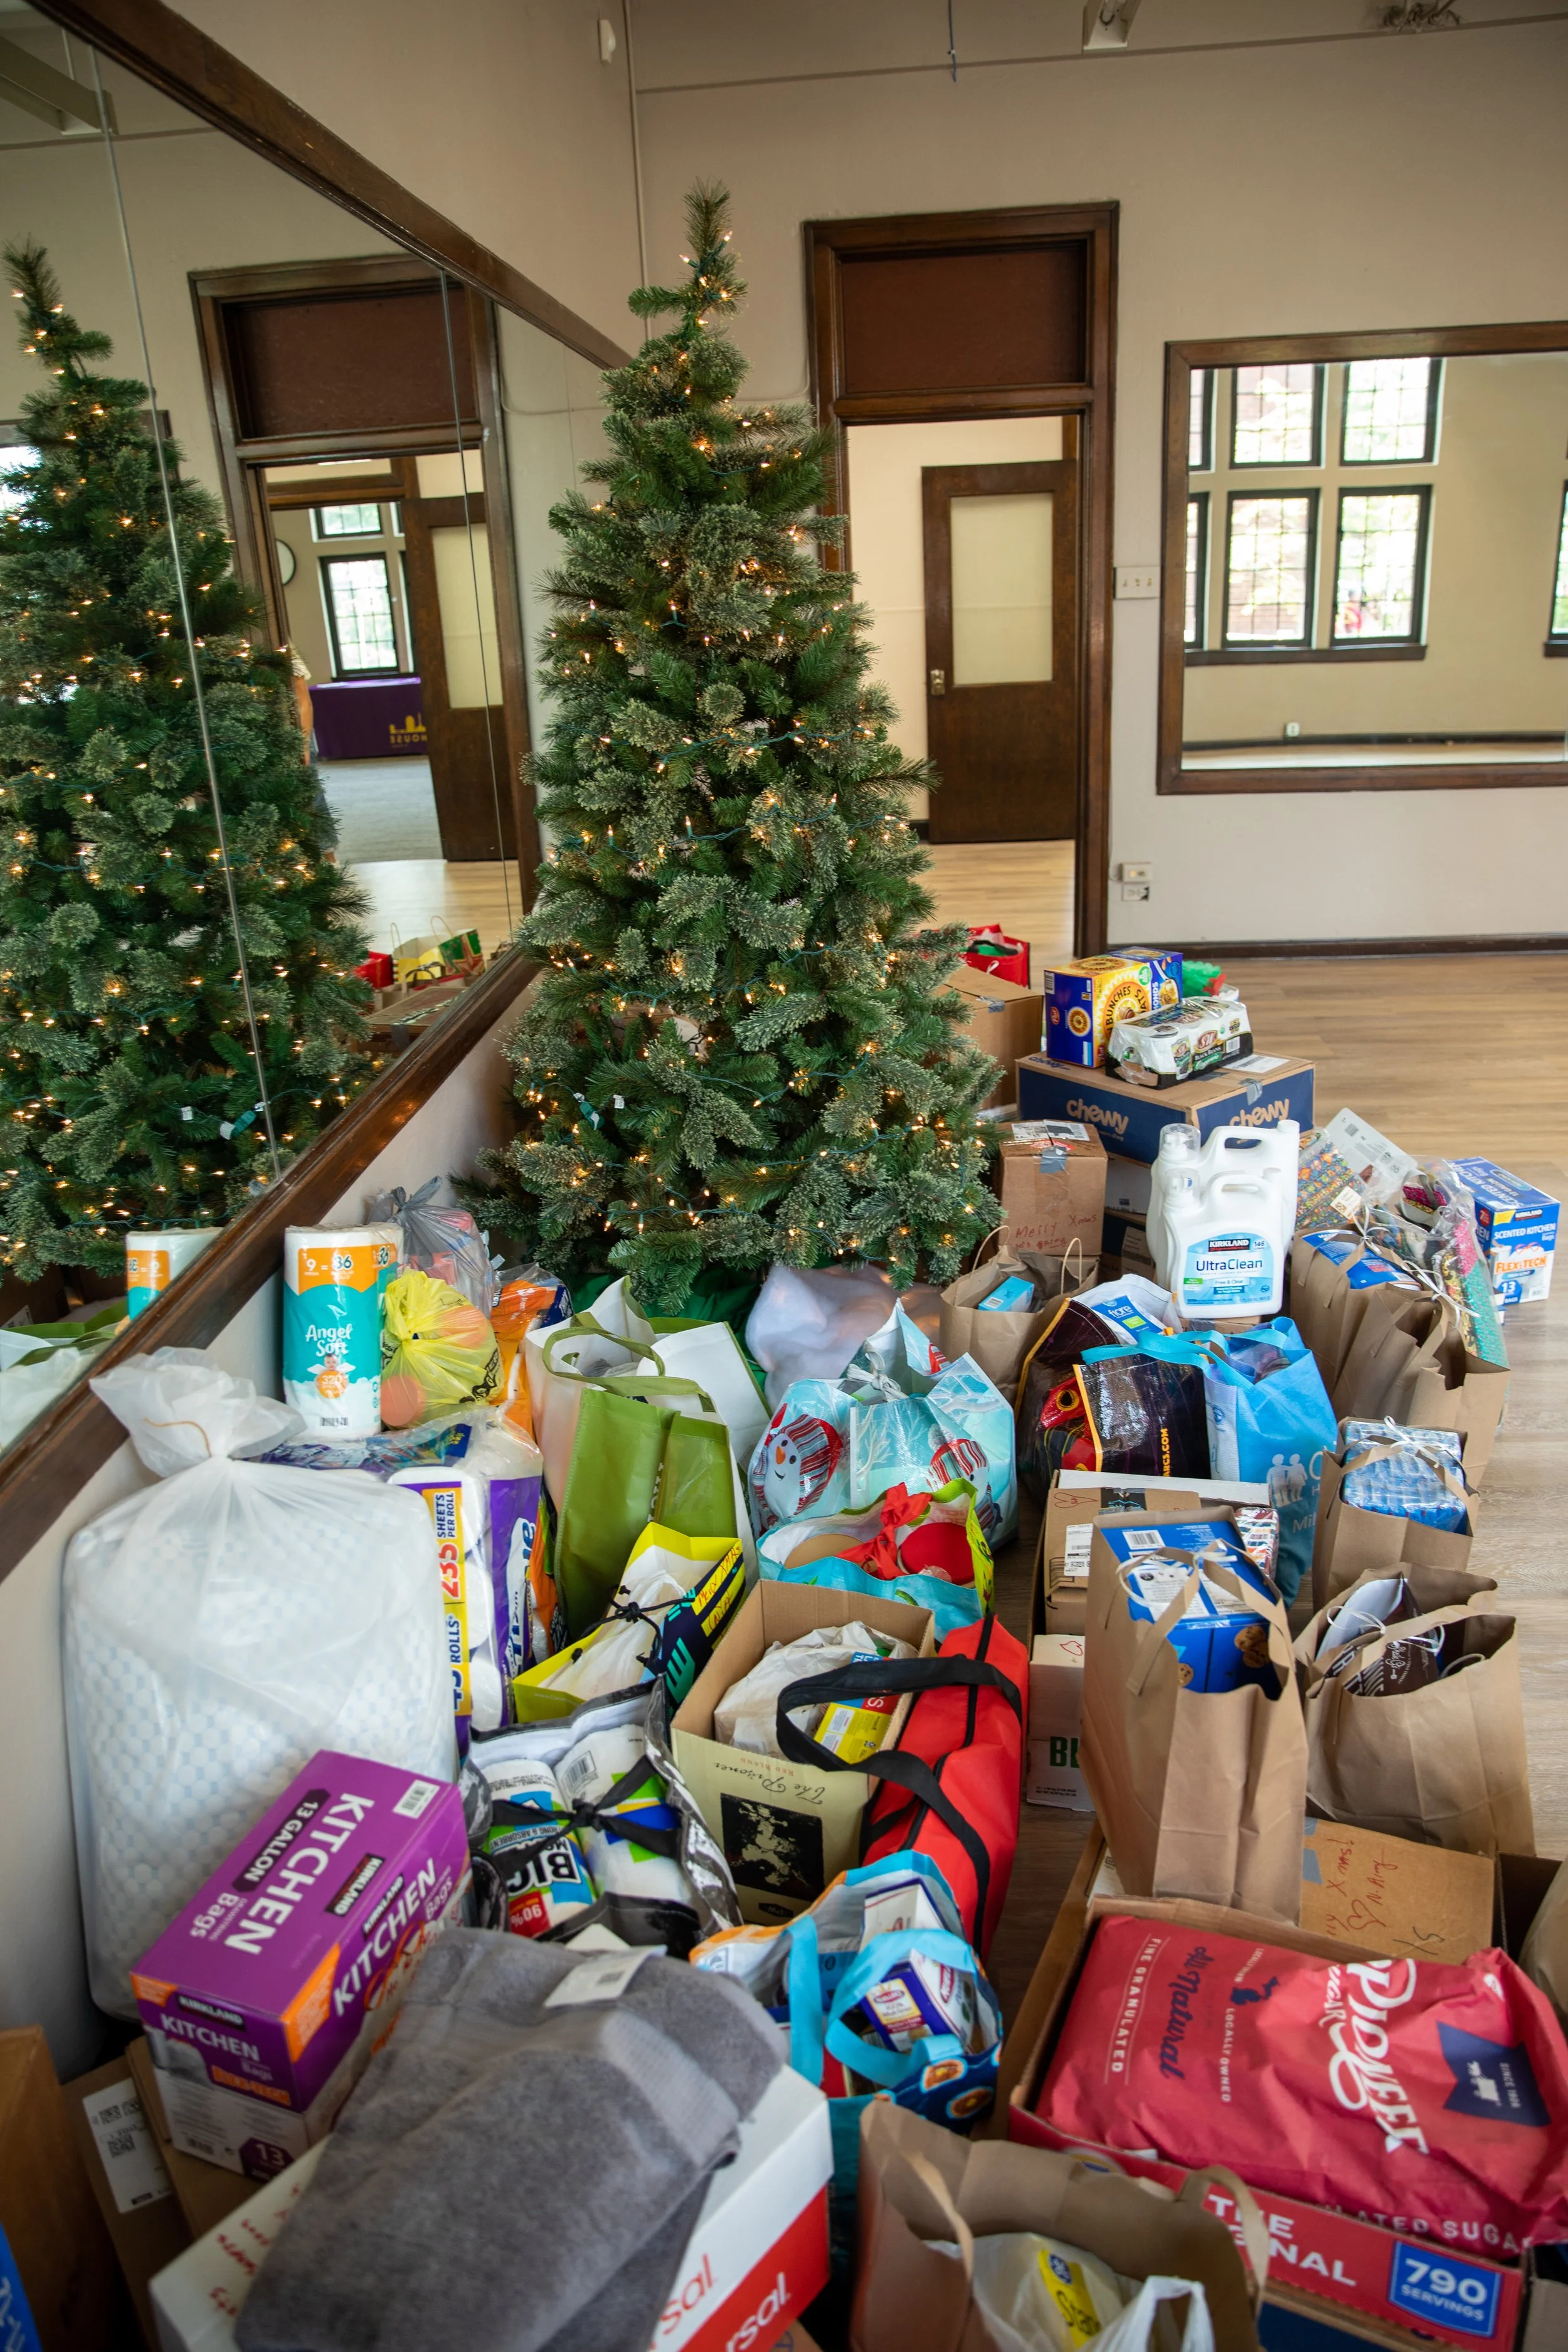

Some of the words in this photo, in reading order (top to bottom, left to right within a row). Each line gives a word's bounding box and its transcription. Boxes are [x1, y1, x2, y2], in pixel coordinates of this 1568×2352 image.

[1106, 986, 1131, 1025] BUNCHES
[1067, 1098, 1128, 1134] chewy
[1229, 1098, 1290, 1127] chewy
[1209, 1239, 1249, 1248] KIRKLAND
[1494, 1228, 1526, 1239] SCENTED
[1527, 1223, 1556, 1235] KITCHEN
[306, 1259, 316, 1271] 9
[332, 1255, 353, 1269] 36
[1196, 1259, 1263, 1271] UltraClean
[1502, 1281, 1516, 1293] 13
[305, 1324, 353, 1342] Angel
[316, 1338, 349, 1357] Soft
[322, 1375, 341, 1384] 320
[437, 1493, 446, 1538] SHEETS
[447, 1491, 455, 1517] ROLL
[1293, 1512, 1316, 1534] Mil
[713, 1762, 787, 1793] Prisoner
[739, 1757, 771, 1772] BLEND
[775, 1766, 794, 1777] RED
[295, 1800, 319, 1820] 13
[793, 1784, 825, 1806] The
[244, 1818, 304, 1883] GALLON
[490, 1828, 531, 1850] ABSORBENT
[225, 1791, 375, 1954] KITCHEN
[334, 1857, 383, 1917] KIRKLAND
[363, 1877, 404, 1933] KIRKLAND
[425, 1877, 453, 1919] Bags
[190, 1892, 238, 1939] Bags
[510, 1904, 542, 1927] 90%
[334, 1858, 438, 2016] KITCHEN
[1140, 1937, 1161, 1963] FINE
[1184, 1946, 1215, 1969] All
[179, 1994, 243, 2025] KIRKLAND
[1111, 1966, 1147, 2072] GRANULATED
[161, 2013, 260, 2062] KITCHEN
[1160, 1971, 1201, 2080] Natural
[1222, 2008, 1236, 2055] LOCALLY
[1219, 2057, 1231, 2103] OWNED
[255, 2143, 283, 2166] 13
[1209, 2194, 1295, 2239] TE
[1405, 2258, 1487, 2306] 790
[1401, 2284, 1485, 2322] SERVINGS
